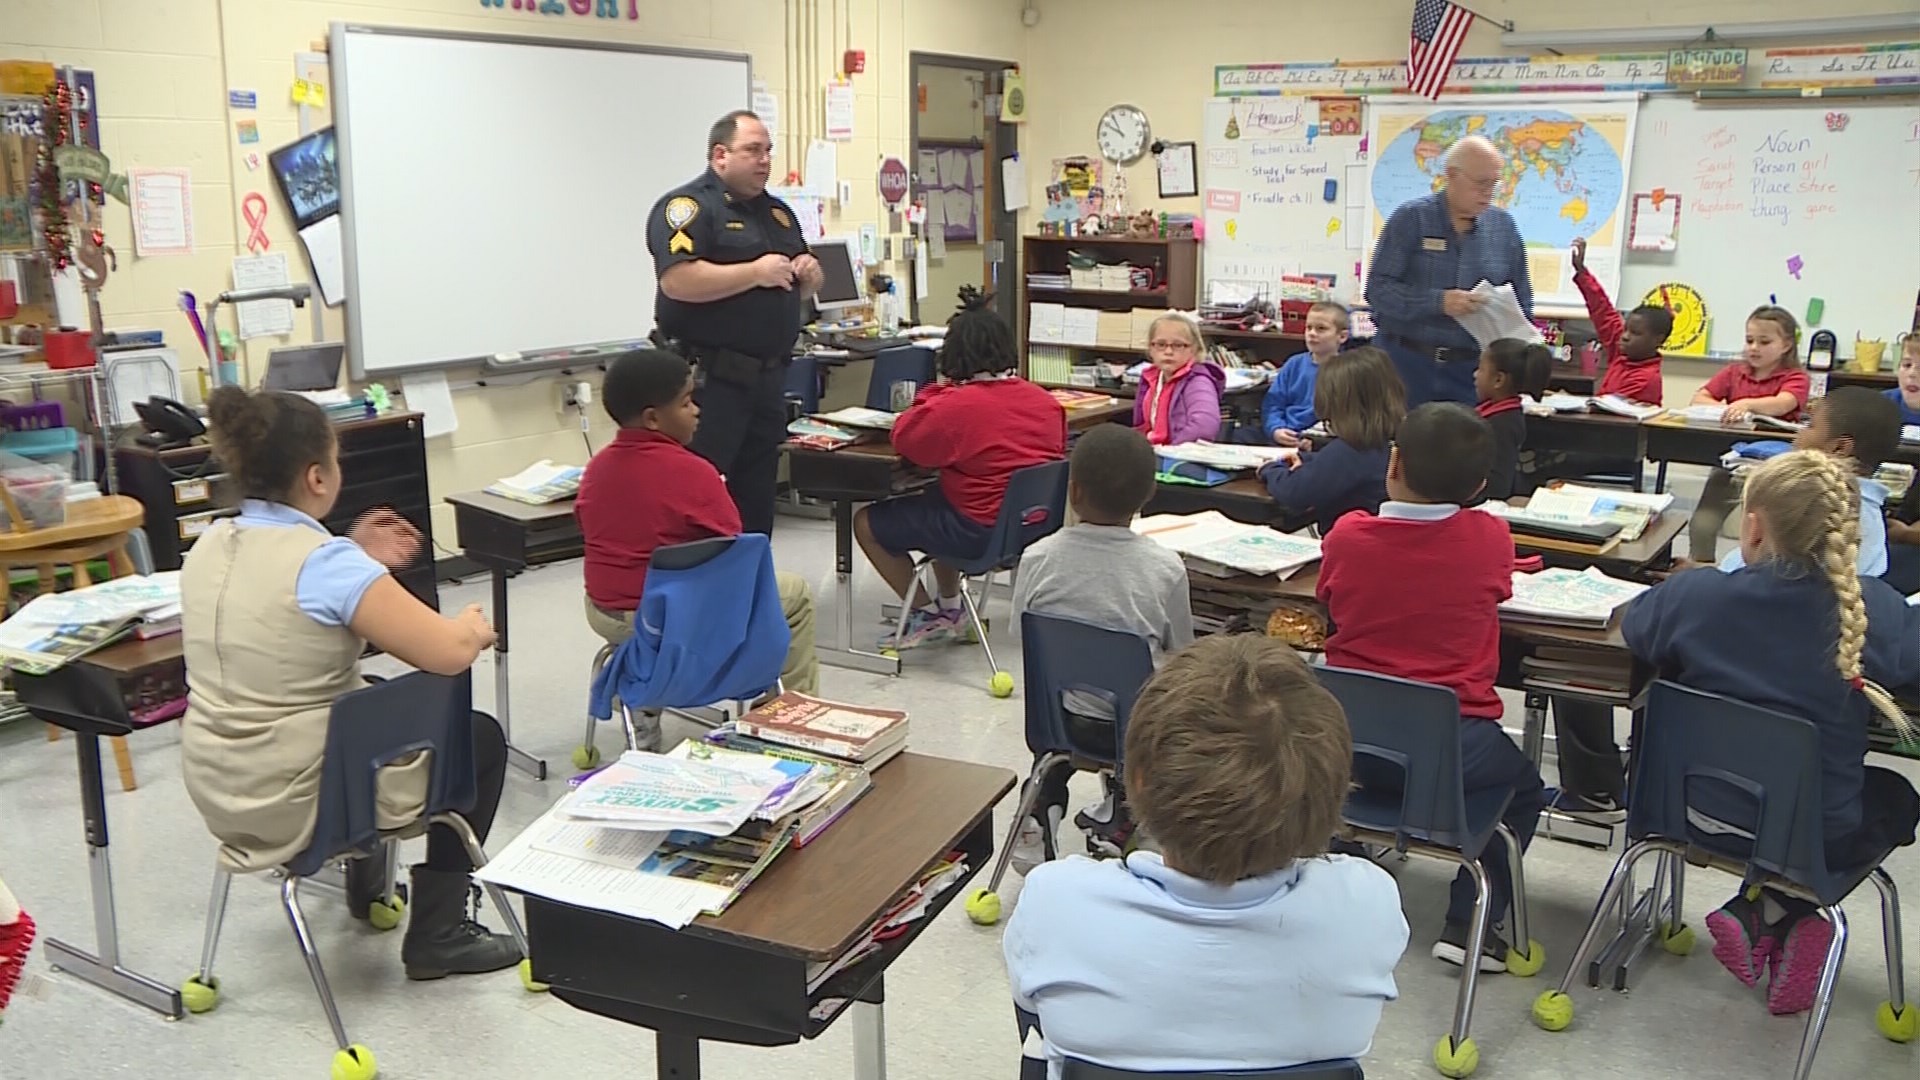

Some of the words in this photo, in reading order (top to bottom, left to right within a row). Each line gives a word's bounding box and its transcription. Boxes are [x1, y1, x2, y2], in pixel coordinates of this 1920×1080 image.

[1755, 129, 1811, 153] Noun
[1252, 166, 1279, 177] Study
[1300, 161, 1327, 176] Speed
[1753, 156, 1796, 174] Person
[1801, 152, 1829, 179] girl
[881, 171, 907, 189] WHOA
[1752, 177, 1793, 195] Place
[1752, 196, 1790, 226] thing
